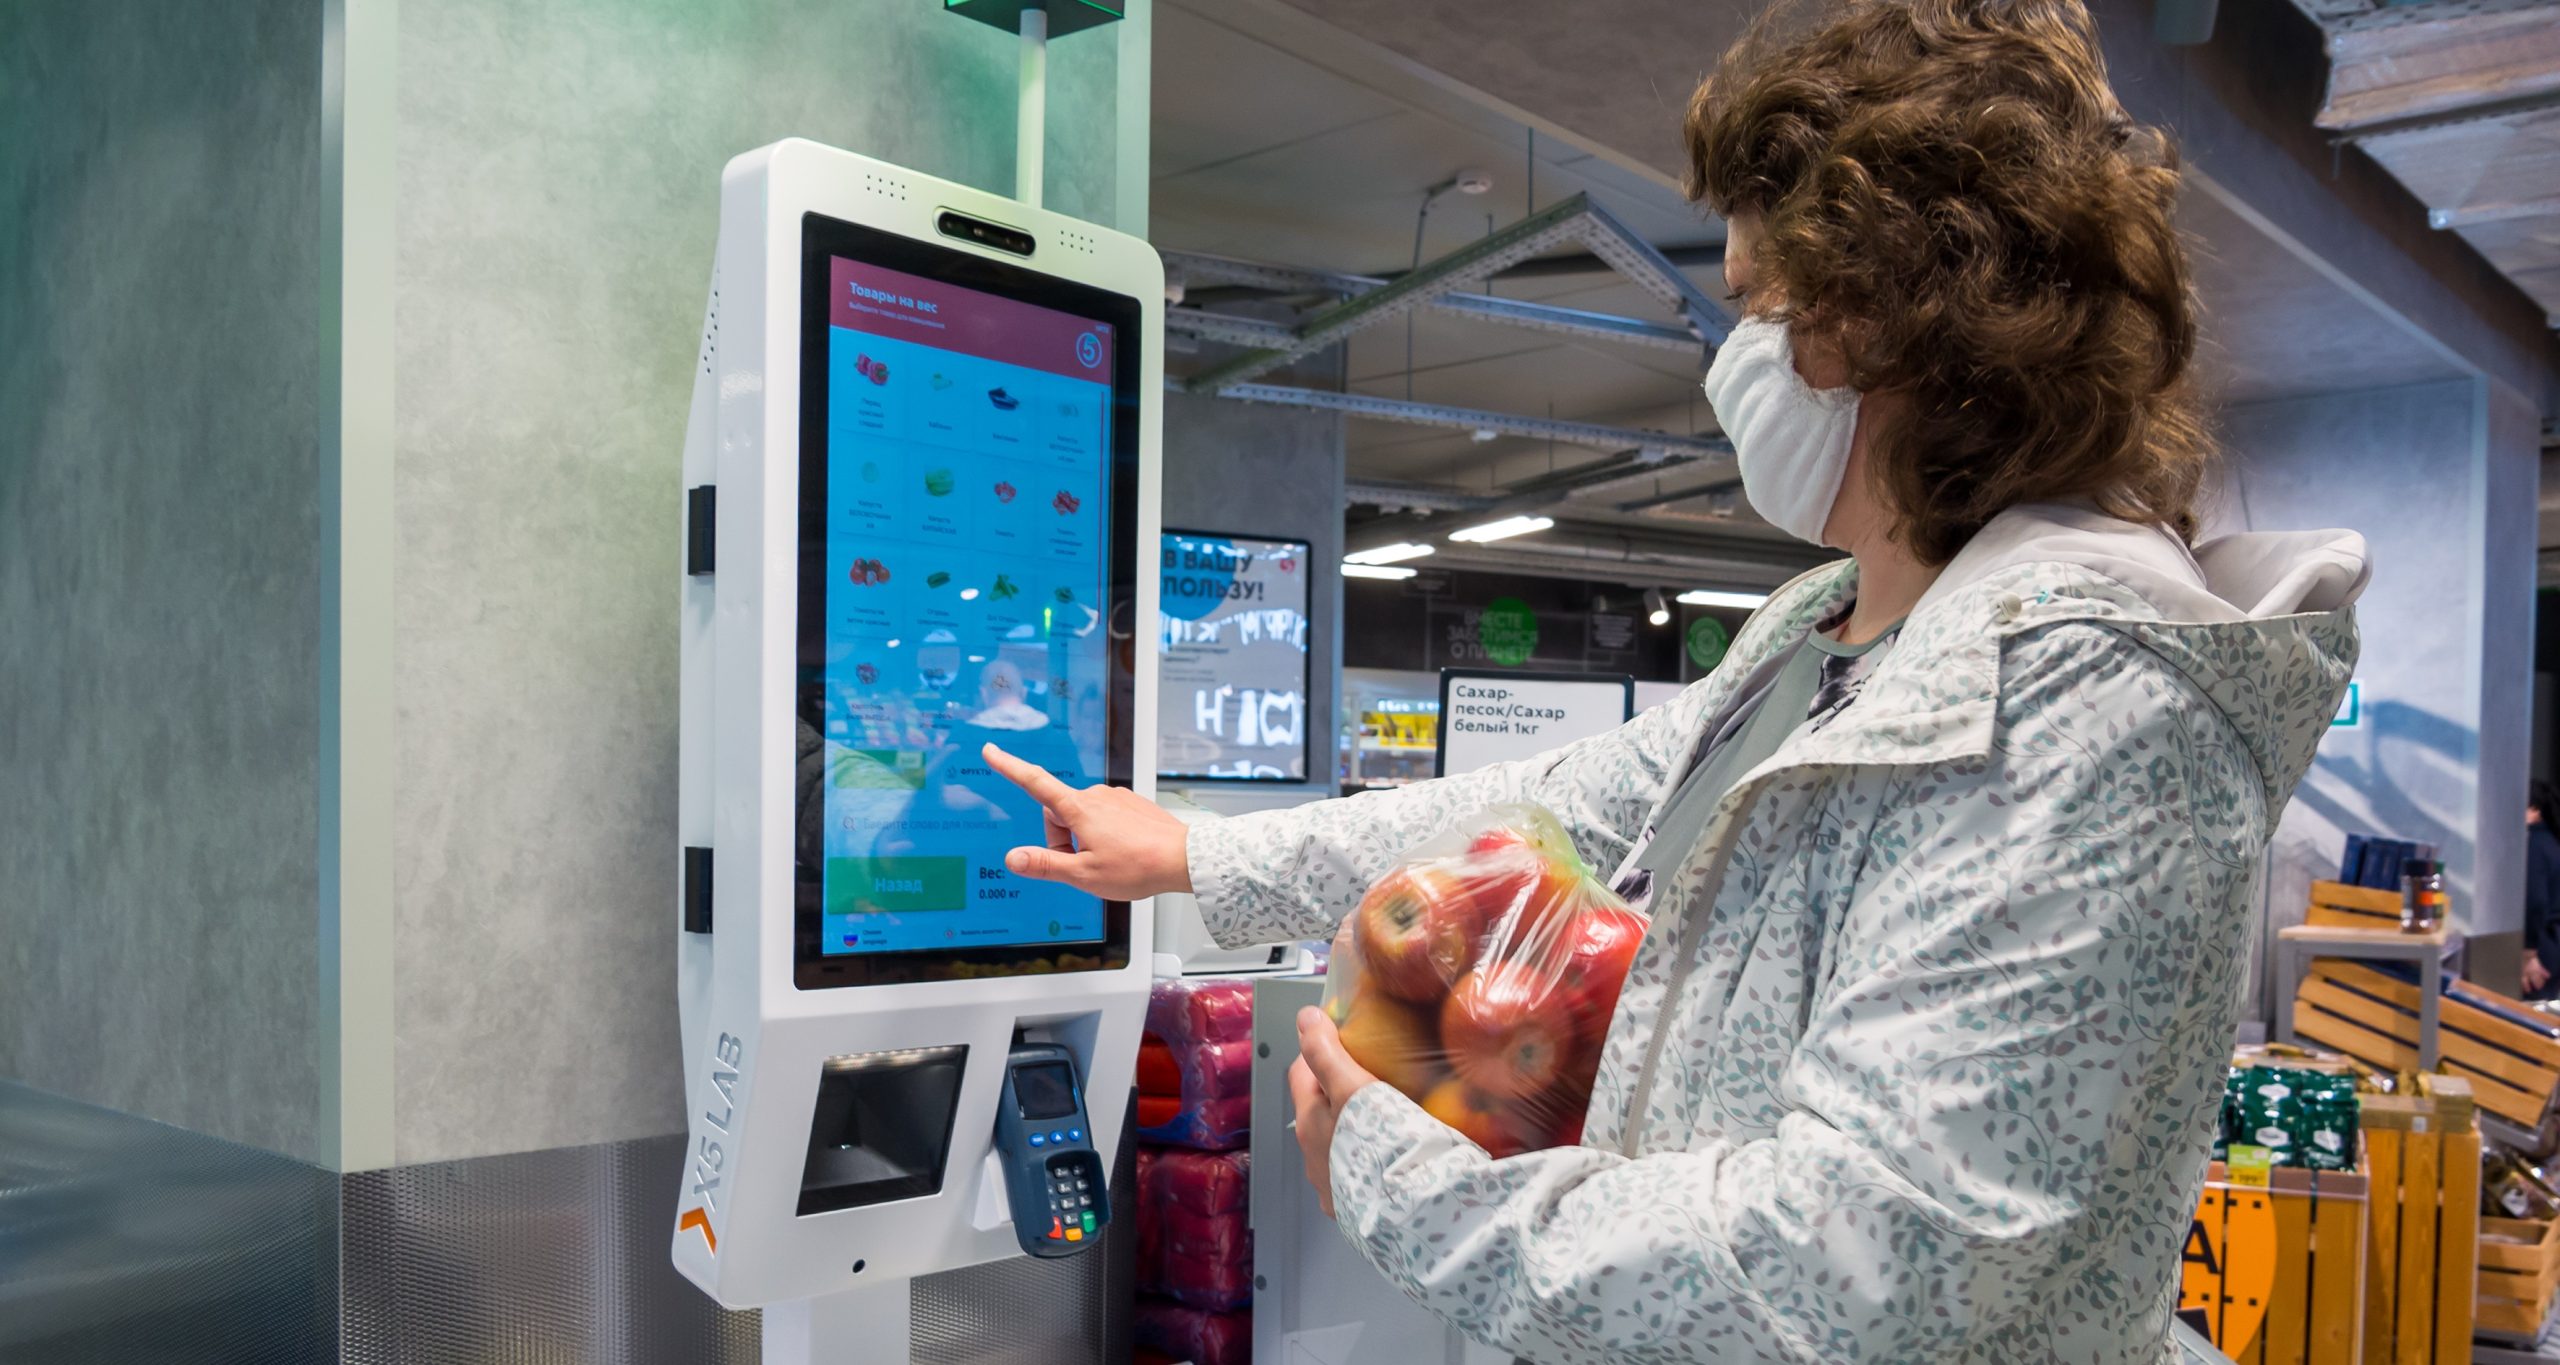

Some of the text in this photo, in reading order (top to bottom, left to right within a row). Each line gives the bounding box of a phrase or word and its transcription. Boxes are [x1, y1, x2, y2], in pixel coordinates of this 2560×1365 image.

[849, 281, 938, 314] Товары на вес
[1164, 549, 1254, 573] В ВАШУ
[1163, 577, 1264, 601] ПОЛЬЗУ!
[1464, 609, 1523, 628] ВМЕСТЕ
[1451, 642, 1466, 659] О
[1456, 685, 1514, 702] Сахар-
[1455, 704, 1565, 722] песок/Сахар
[1454, 719, 1540, 735] белый 1кг
[961, 767, 992, 776] ФРУКТЫ
[979, 866, 1006, 879] Вес:
[875, 877, 923, 894] Назад
[979, 888, 1021, 899] 0.000 кг
[692, 1031, 743, 1213] X5 LAB
